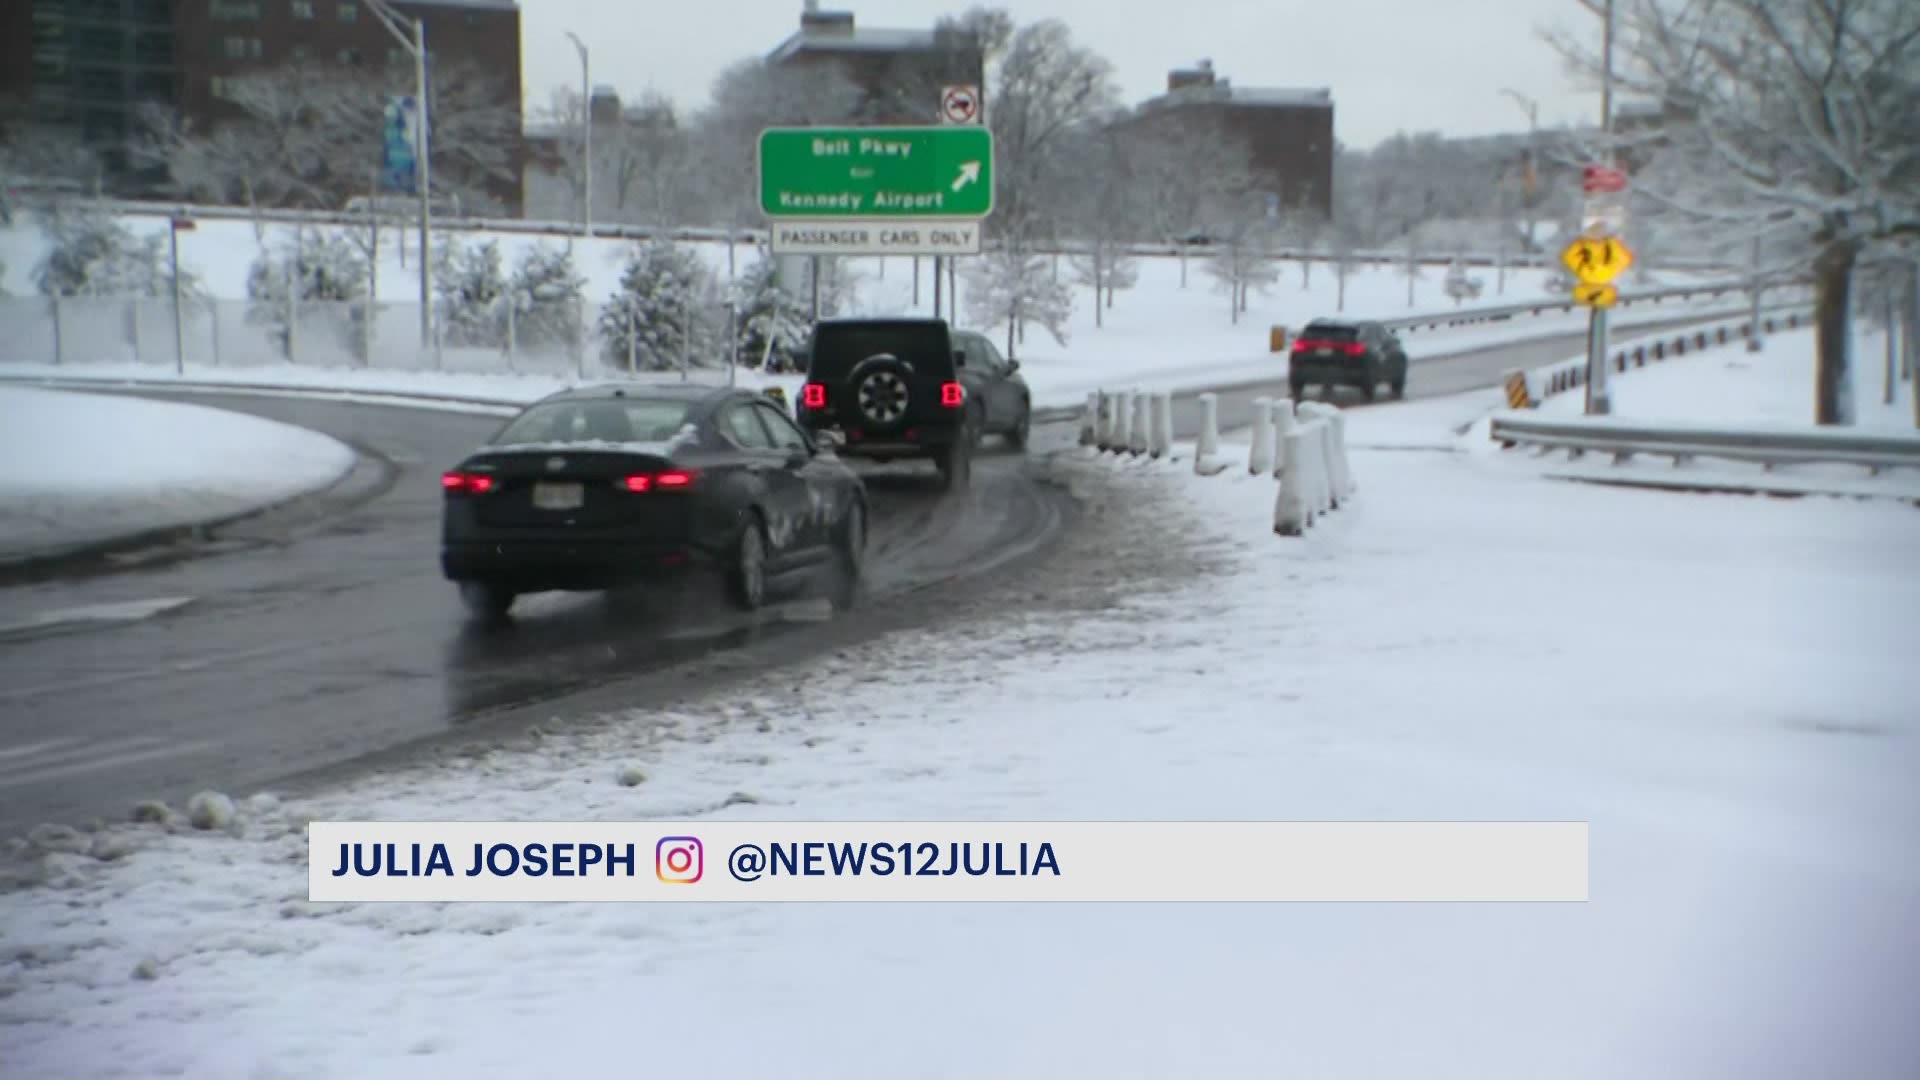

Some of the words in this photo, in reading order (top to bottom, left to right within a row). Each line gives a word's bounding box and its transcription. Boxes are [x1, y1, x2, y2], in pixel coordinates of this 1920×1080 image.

[859, 138, 912, 160] Pkwy
[780, 191, 863, 210] Kennedy
[873, 191, 944, 209] Airport
[781, 230, 869, 245] PASSENGER
[879, 230, 920, 245] CARS
[930, 230, 972, 245] ONLY
